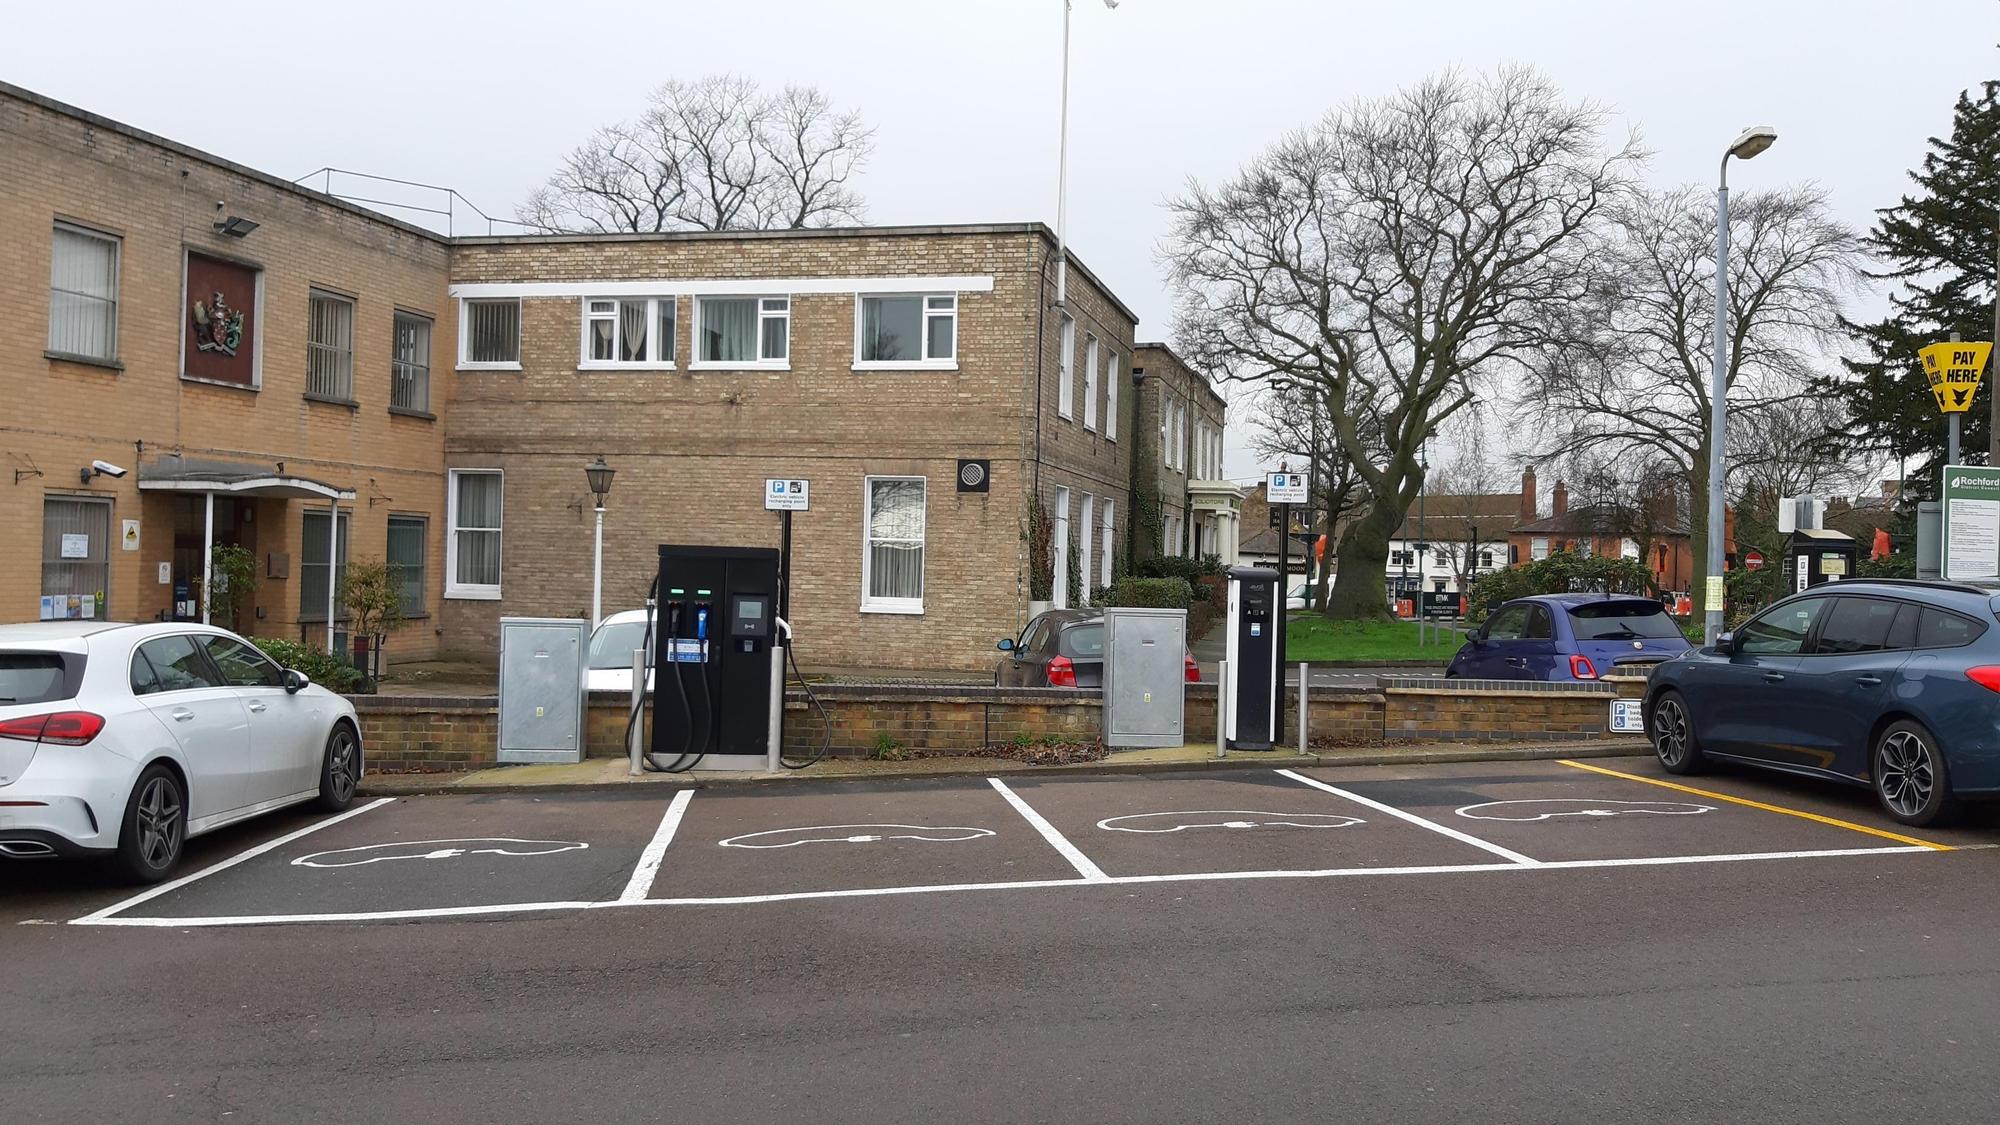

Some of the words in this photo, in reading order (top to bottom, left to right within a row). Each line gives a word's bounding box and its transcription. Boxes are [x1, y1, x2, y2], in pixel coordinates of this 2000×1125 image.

[1925, 353, 1937, 369] PAY
[1952, 351, 1976, 365] PAY
[1946, 369, 1978, 383] HERE
[1960, 476, 2000, 486] Rochford
[1616, 704, 1624, 714] P
